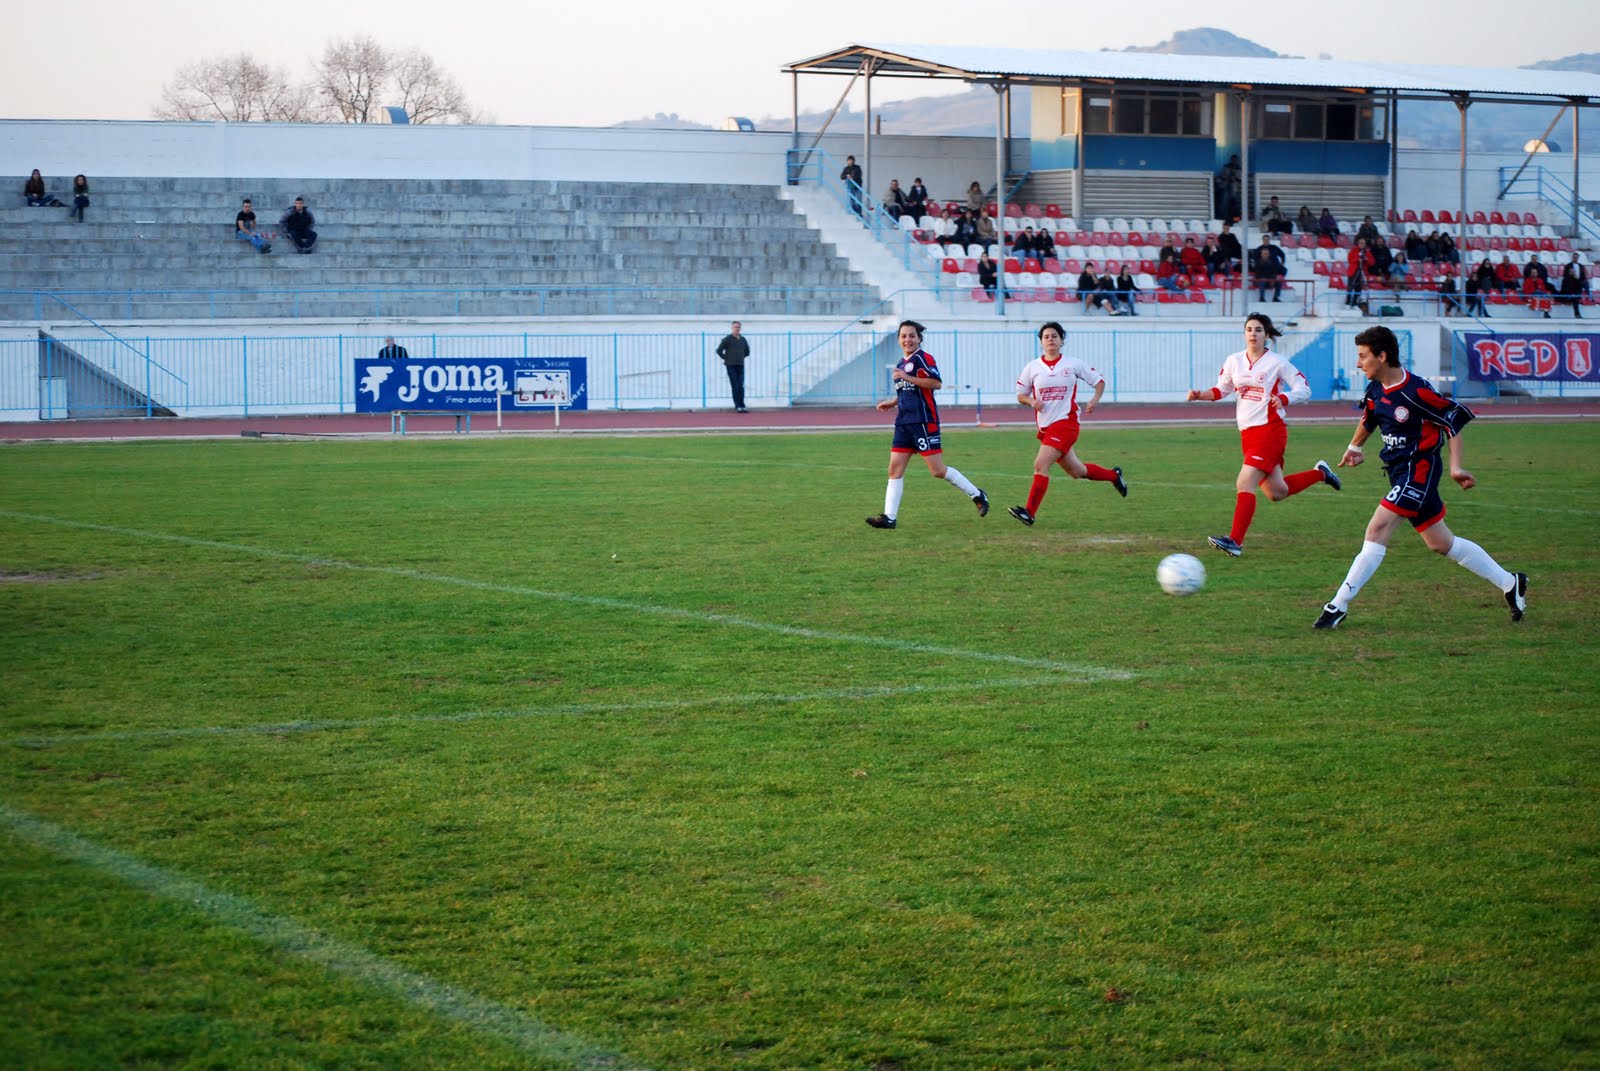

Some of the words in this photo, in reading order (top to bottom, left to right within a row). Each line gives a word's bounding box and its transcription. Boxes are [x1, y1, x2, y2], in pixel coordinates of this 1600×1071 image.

[1473, 338, 1559, 377] RED
[917, 437, 927, 450] 3
[1385, 485, 1401, 502] 8
